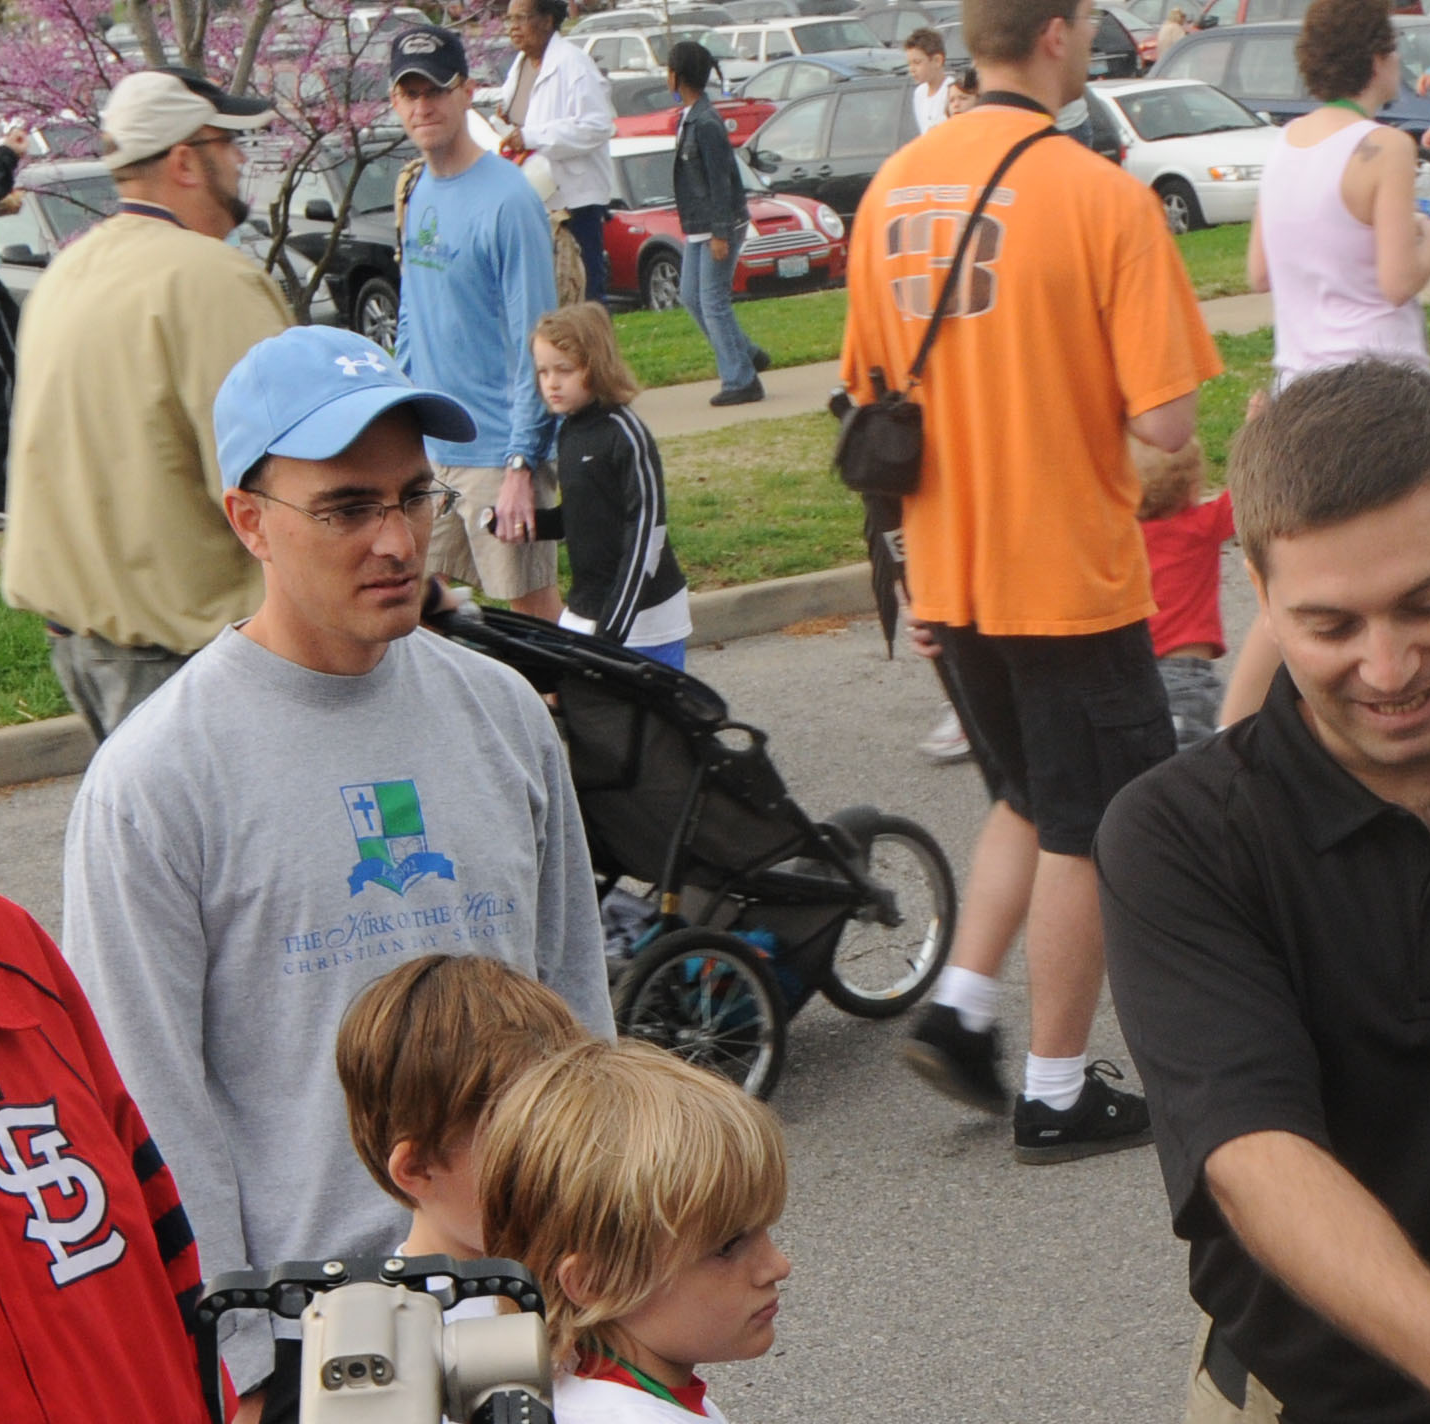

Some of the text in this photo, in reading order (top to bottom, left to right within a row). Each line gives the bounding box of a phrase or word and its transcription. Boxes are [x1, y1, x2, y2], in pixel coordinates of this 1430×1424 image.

[283, 931, 322, 954] THE
[325, 909, 396, 949] KIRK
[411, 904, 452, 928] THE
[283, 939, 405, 976] CHRISTIAN
